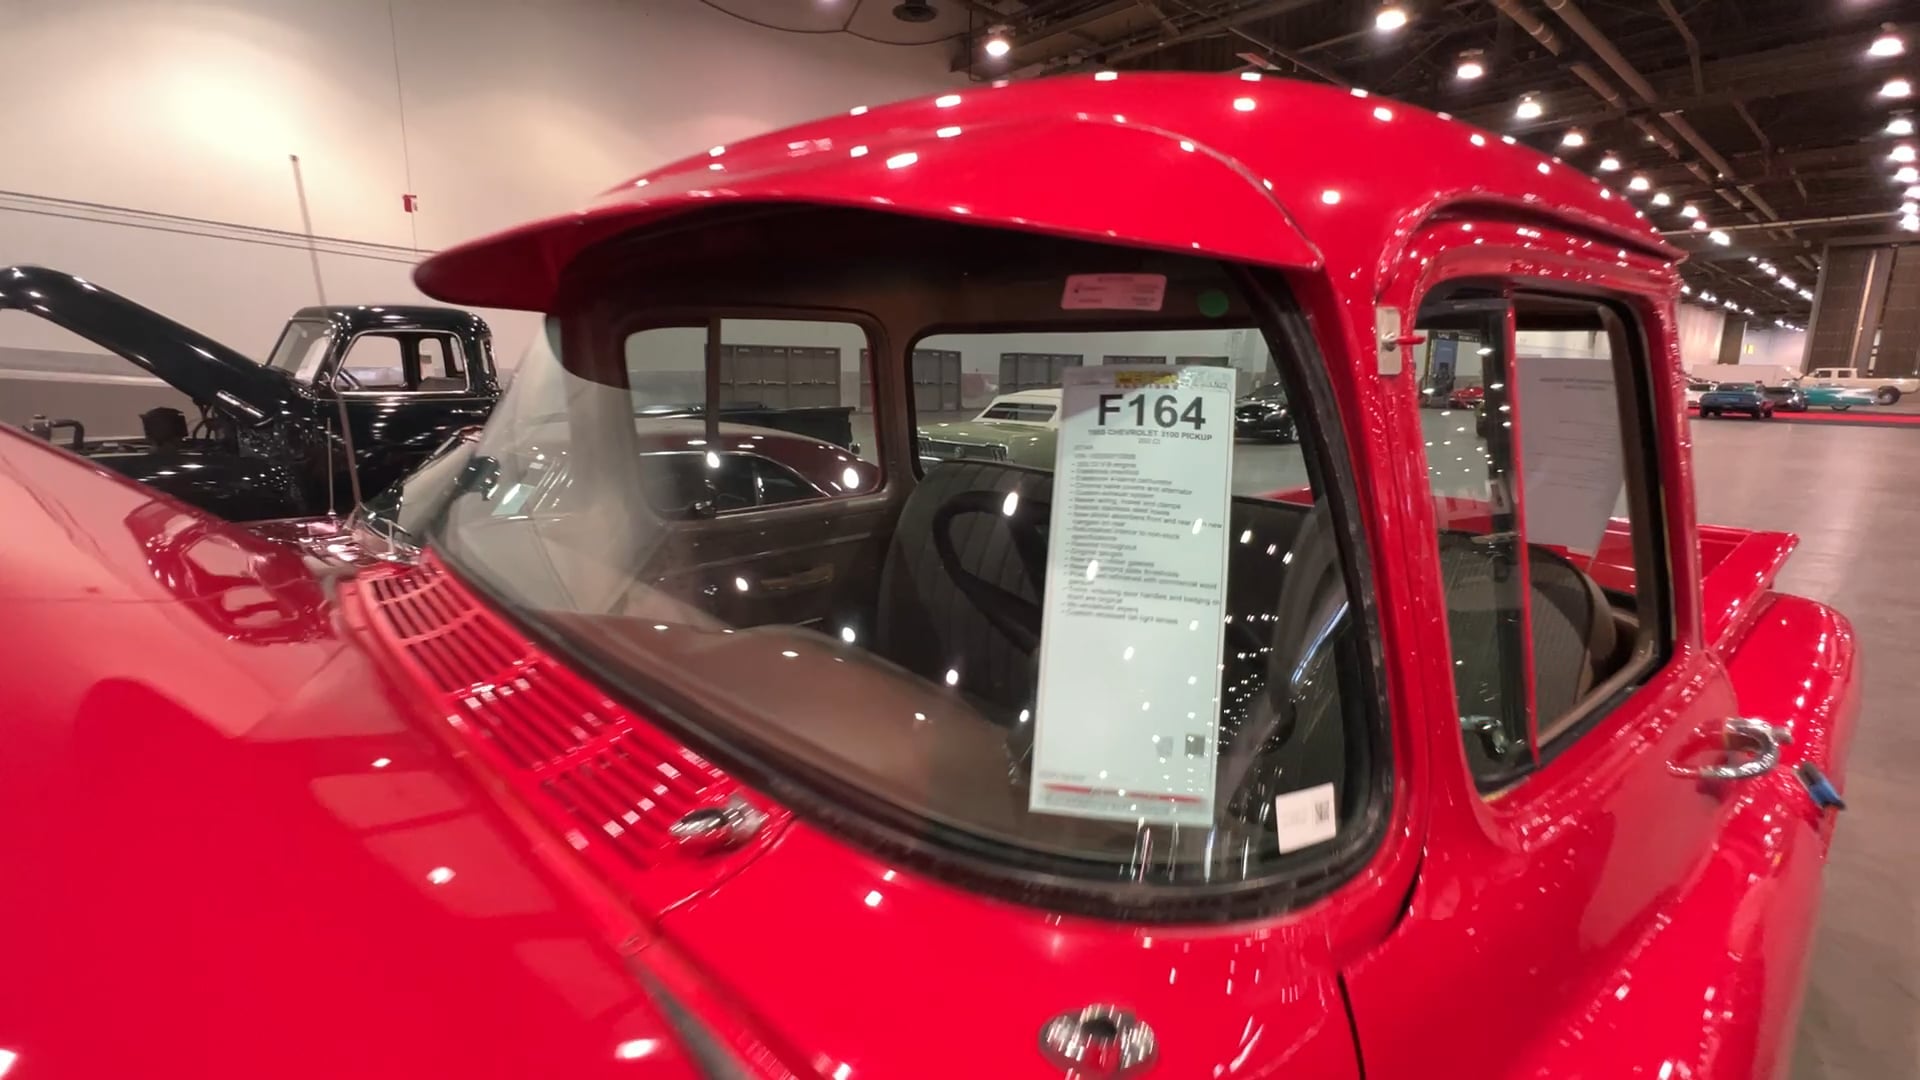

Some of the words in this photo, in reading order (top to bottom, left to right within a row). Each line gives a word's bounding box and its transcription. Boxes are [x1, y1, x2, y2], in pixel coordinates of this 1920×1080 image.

[1098, 394, 1206, 430] F164
[1107, 429, 1158, 437] CHEVROLET
[1181, 432, 1213, 441] PICKUP
